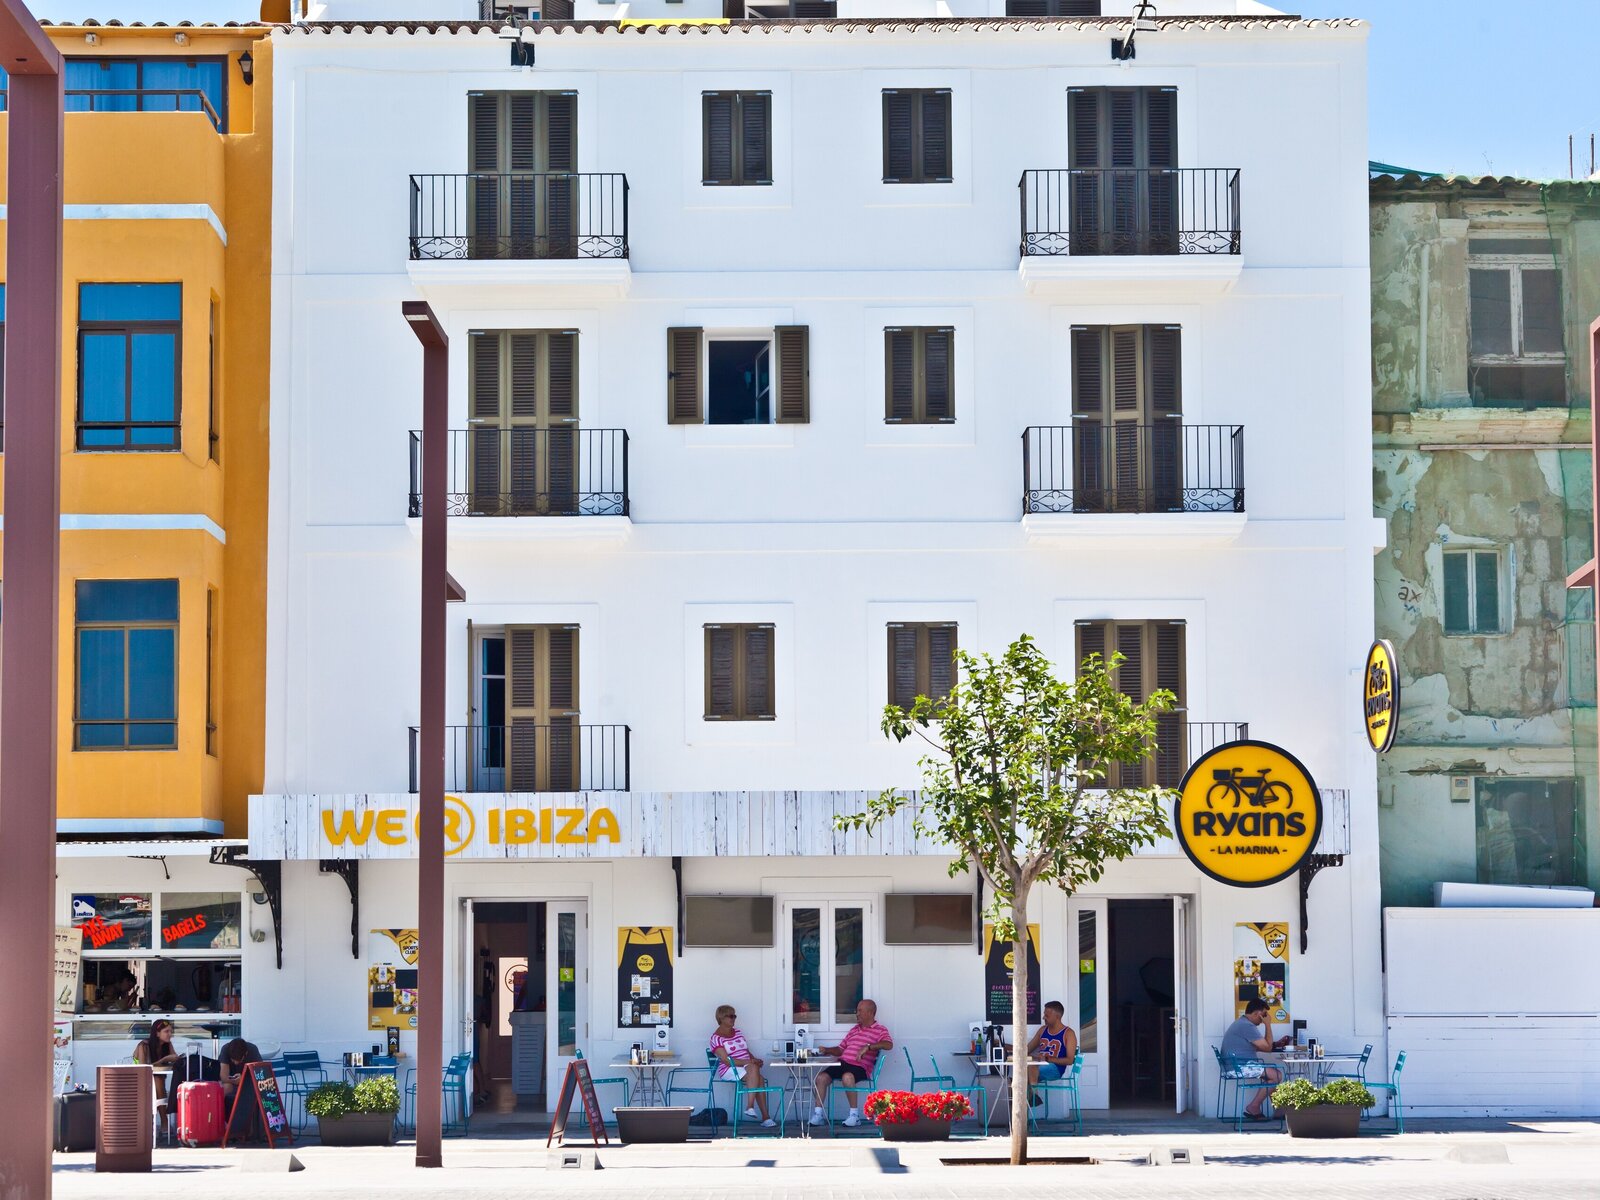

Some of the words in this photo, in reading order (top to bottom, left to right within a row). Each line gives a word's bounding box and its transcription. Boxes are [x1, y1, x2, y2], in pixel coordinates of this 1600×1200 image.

[322, 809, 407, 846] WE
[488, 807, 621, 844] IBIZA
[1193, 811, 1307, 837] Ryans
[1218, 845, 1233, 855] LA
[1235, 845, 1280, 855] MARINA
[92, 921, 124, 949] AWAY
[162, 914, 206, 943] BAGELS
[1040, 1038, 1060, 1057] 23
